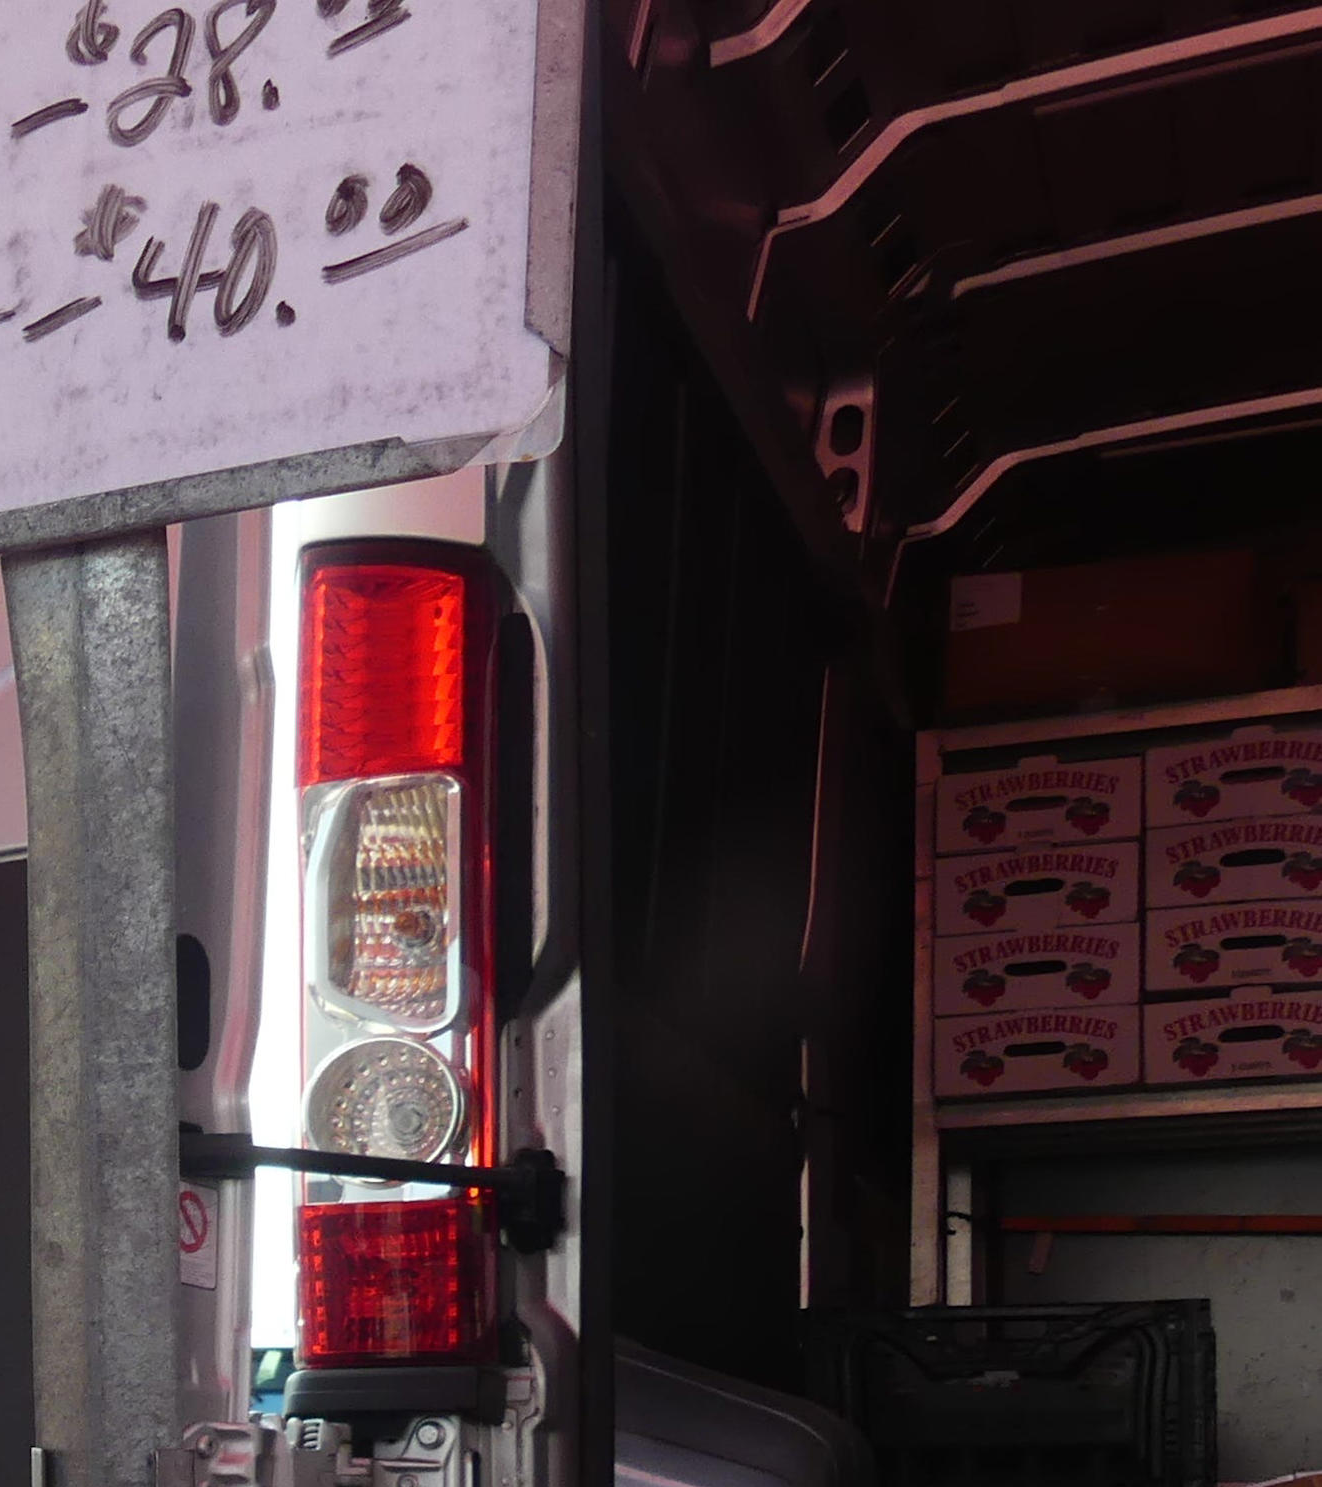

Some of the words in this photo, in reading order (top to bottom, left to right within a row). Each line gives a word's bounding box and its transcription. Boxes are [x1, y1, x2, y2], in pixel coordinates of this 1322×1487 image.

[955, 770, 1120, 811] STRAWBERRIES
[954, 854, 1119, 893] STRAWBERRIES
[953, 934, 1120, 973] STRAWBERRIES
[953, 1014, 1118, 1053] STRAWBERRIES
